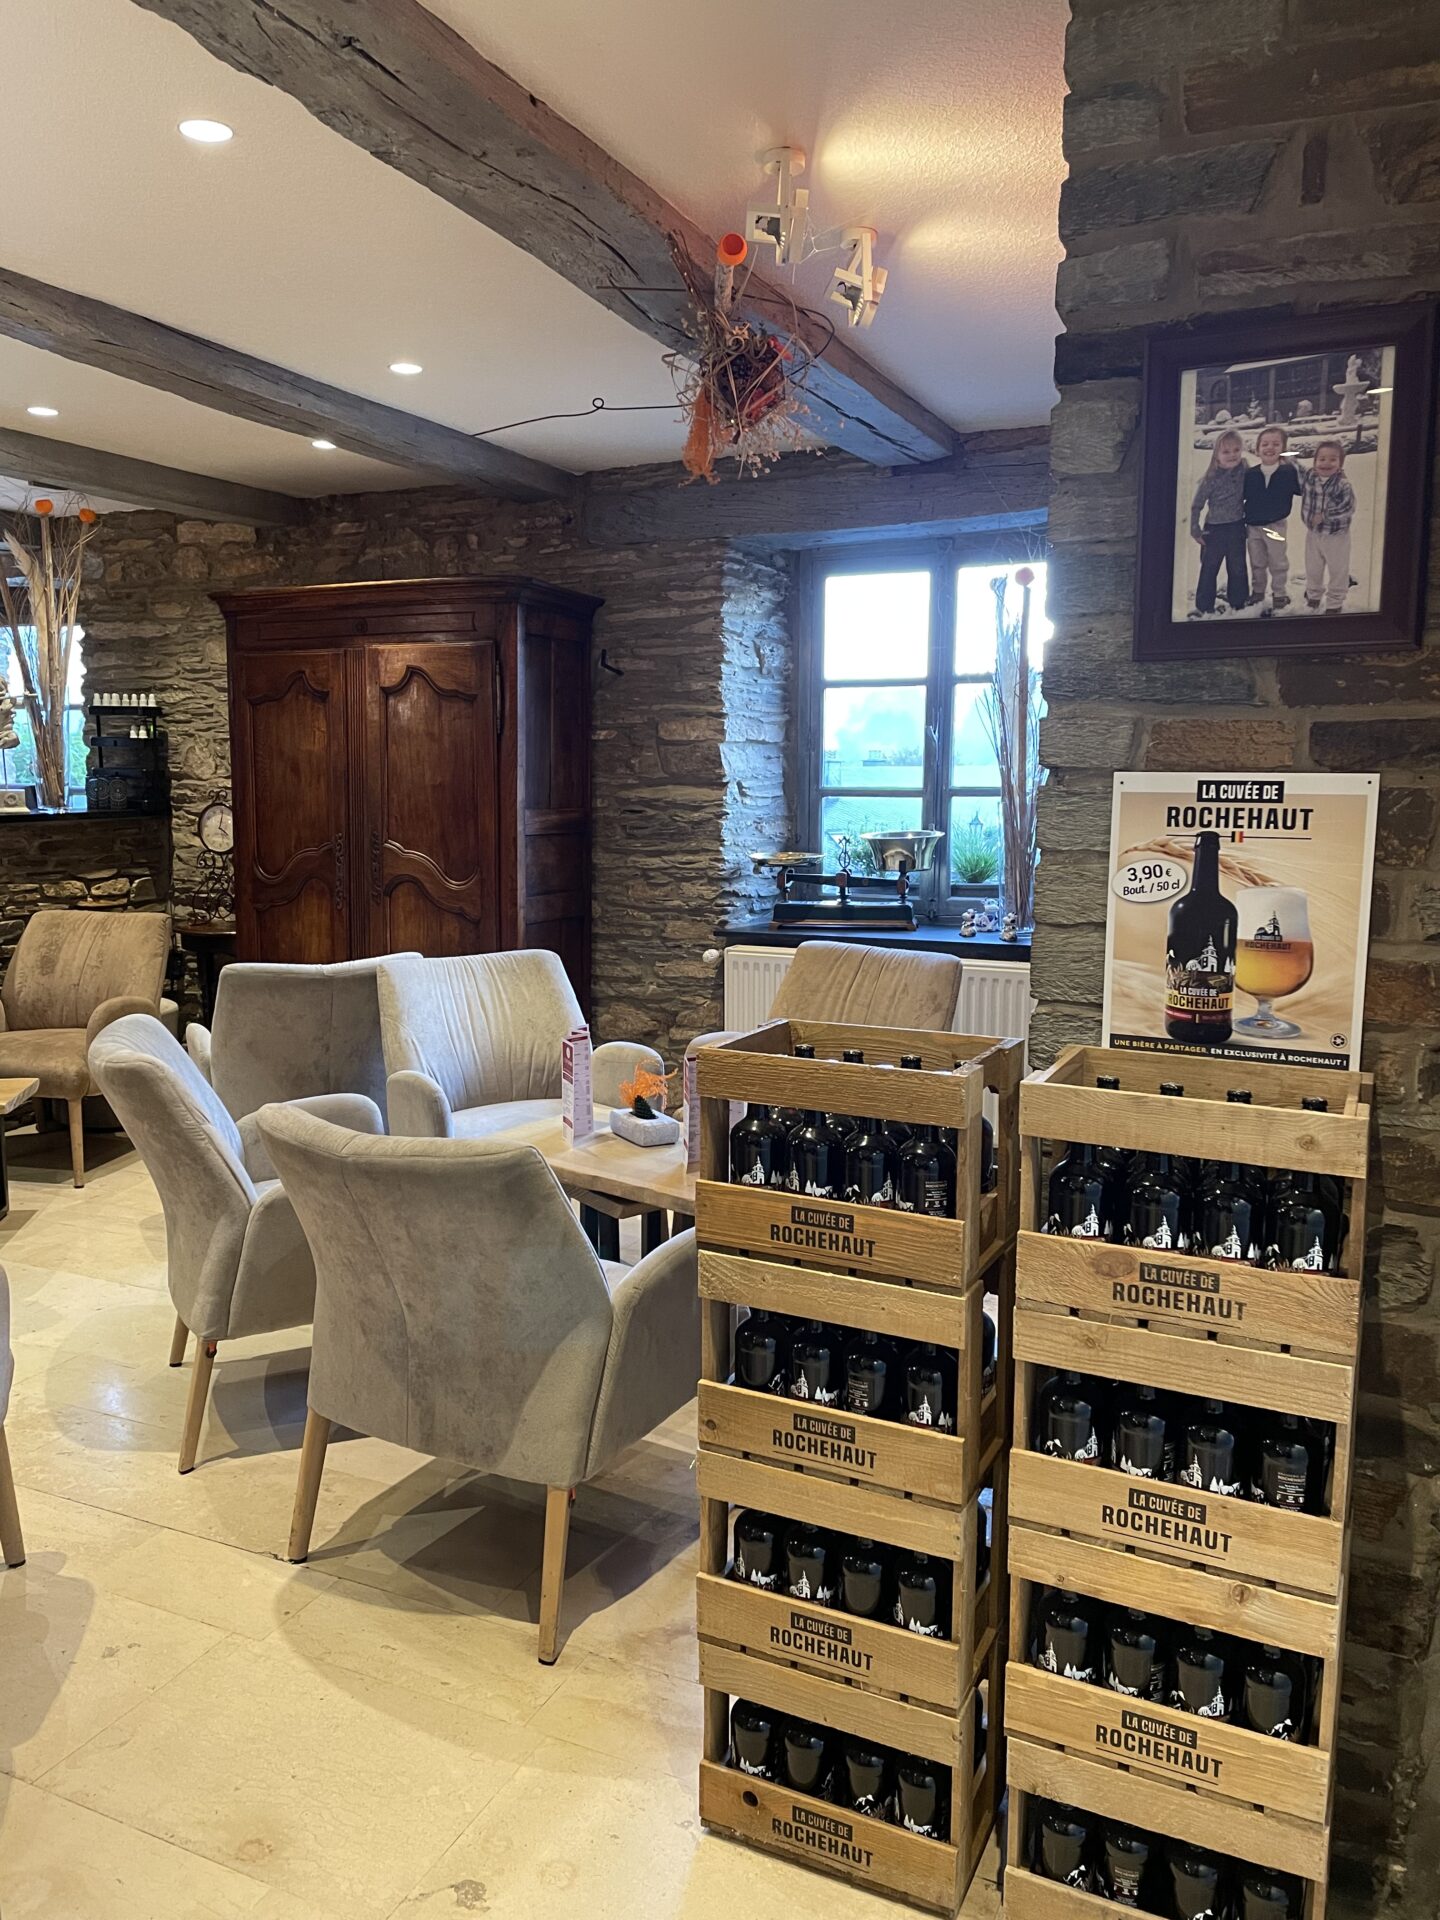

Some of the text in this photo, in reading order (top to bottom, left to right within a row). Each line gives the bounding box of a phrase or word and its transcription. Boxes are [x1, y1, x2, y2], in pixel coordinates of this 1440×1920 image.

[1202, 782, 1279, 800] LA CUVÉE DE
[1166, 806, 1314, 831] ROCHEHAUT
[1123, 885, 1147, 896] Bout.
[1156, 881, 1169, 891] 50
[1171, 879, 1180, 889] cl
[1127, 864, 1163, 884] 3,90
[1167, 993, 1230, 1010] ROCHEHAUT
[1114, 1039, 1130, 1047] UNE
[1132, 1040, 1155, 1049] BIÈRE
[1156, 1041, 1163, 1049] À
[1224, 1048, 1278, 1060] EXCLUSIVITÉ
[1279, 1053, 1287, 1061] À
[1288, 1055, 1341, 1066] ROCHEHAUT
[795, 1209, 850, 1230] LA CUVÉE DE
[770, 1224, 876, 1258] ROCHEHAUT
[1144, 1266, 1215, 1289] LA CUVÉE DE
[1113, 1282, 1247, 1320] ROCHEHAUT
[797, 1416, 852, 1440] LA CUVÉE DE
[773, 1429, 877, 1469] ROCHEHAUT
[1133, 1492, 1202, 1520] LA CUVÉE DE
[1102, 1505, 1232, 1552] ROCHEHAUT
[794, 1615, 848, 1642] LA CUVÉE DE
[770, 1626, 873, 1670] ROCHEHAUT
[1126, 1714, 1193, 1745] LA CUVÉE DE
[1096, 1724, 1223, 1778] ROCHEHAUT
[795, 1809, 849, 1838] LA CUVÉE DE
[772, 1818, 873, 1867] ROCHEHAUT
